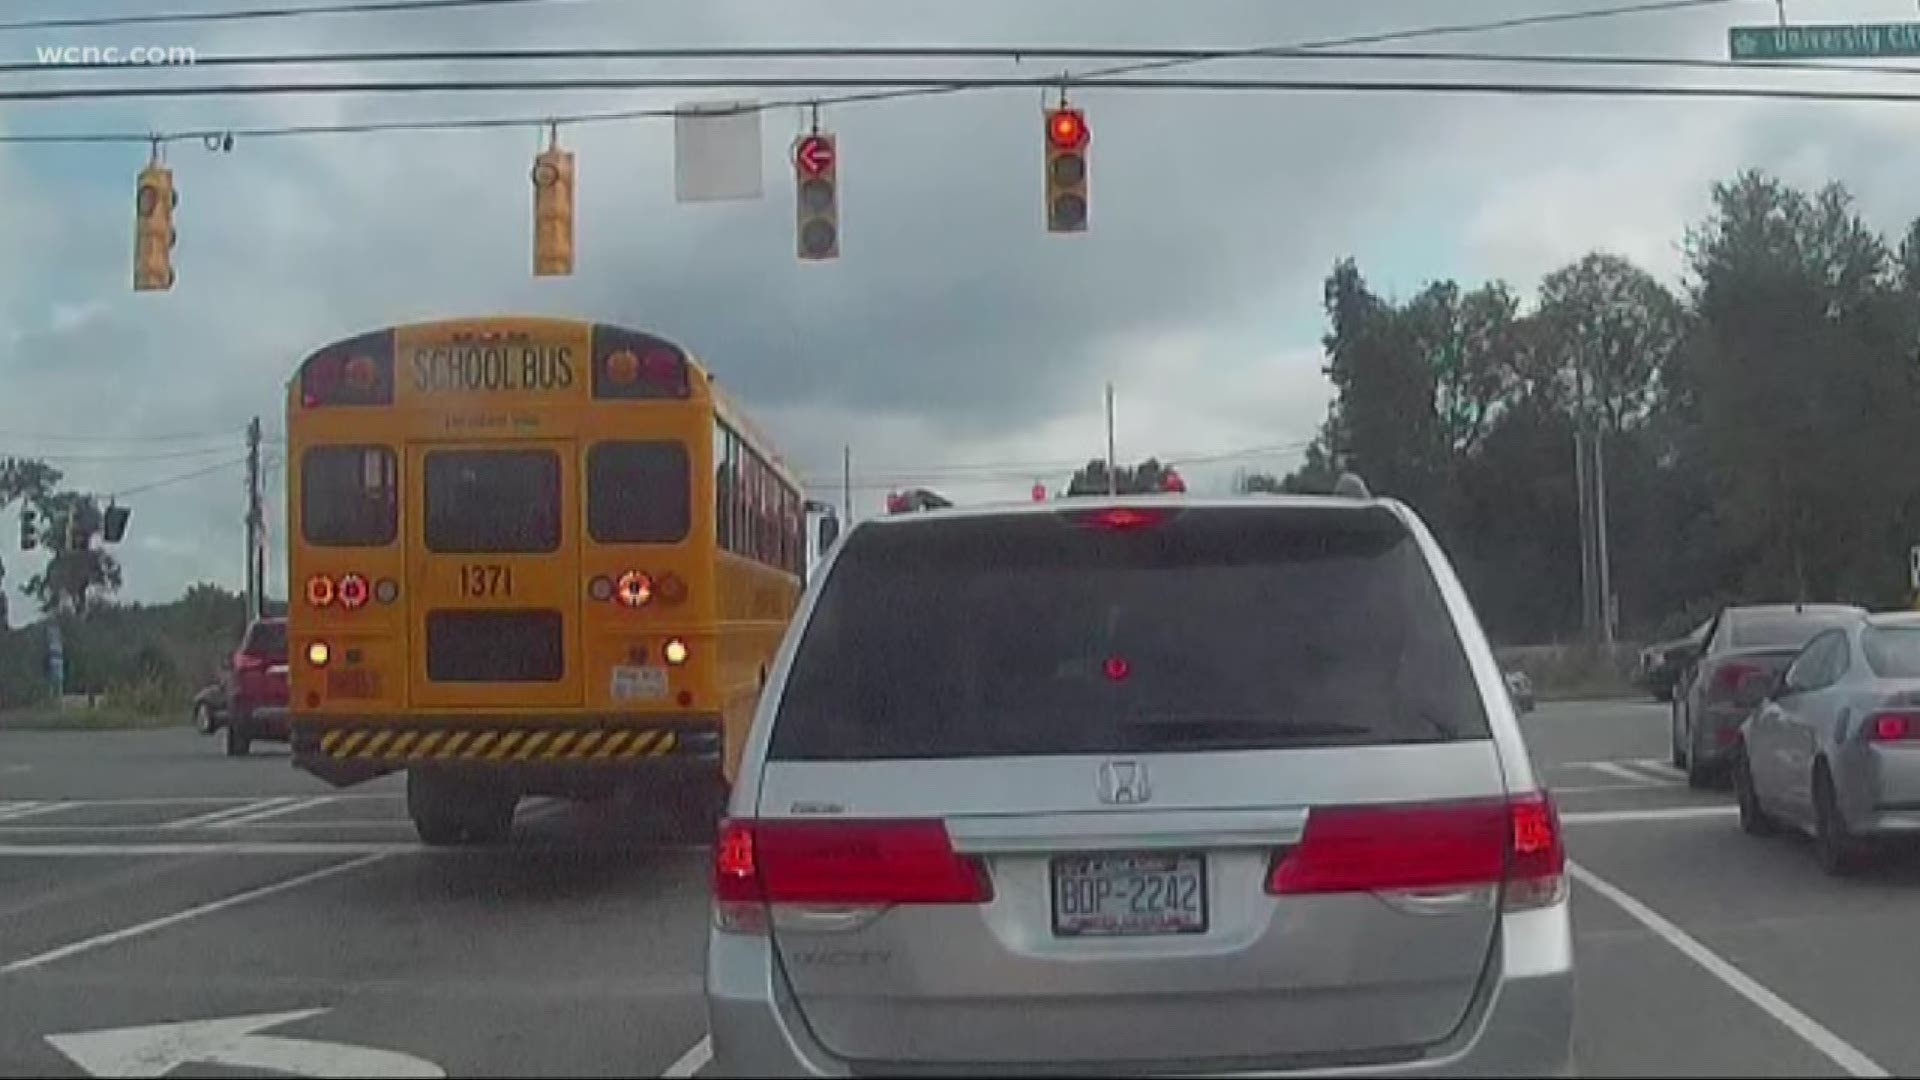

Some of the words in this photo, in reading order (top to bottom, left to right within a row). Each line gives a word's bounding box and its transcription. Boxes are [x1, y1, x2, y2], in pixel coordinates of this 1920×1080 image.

[1774, 25, 1881, 54] University
[413, 346, 515, 391] SCHOOL
[522, 345, 573, 389] BUS
[461, 564, 512, 597] 1371
